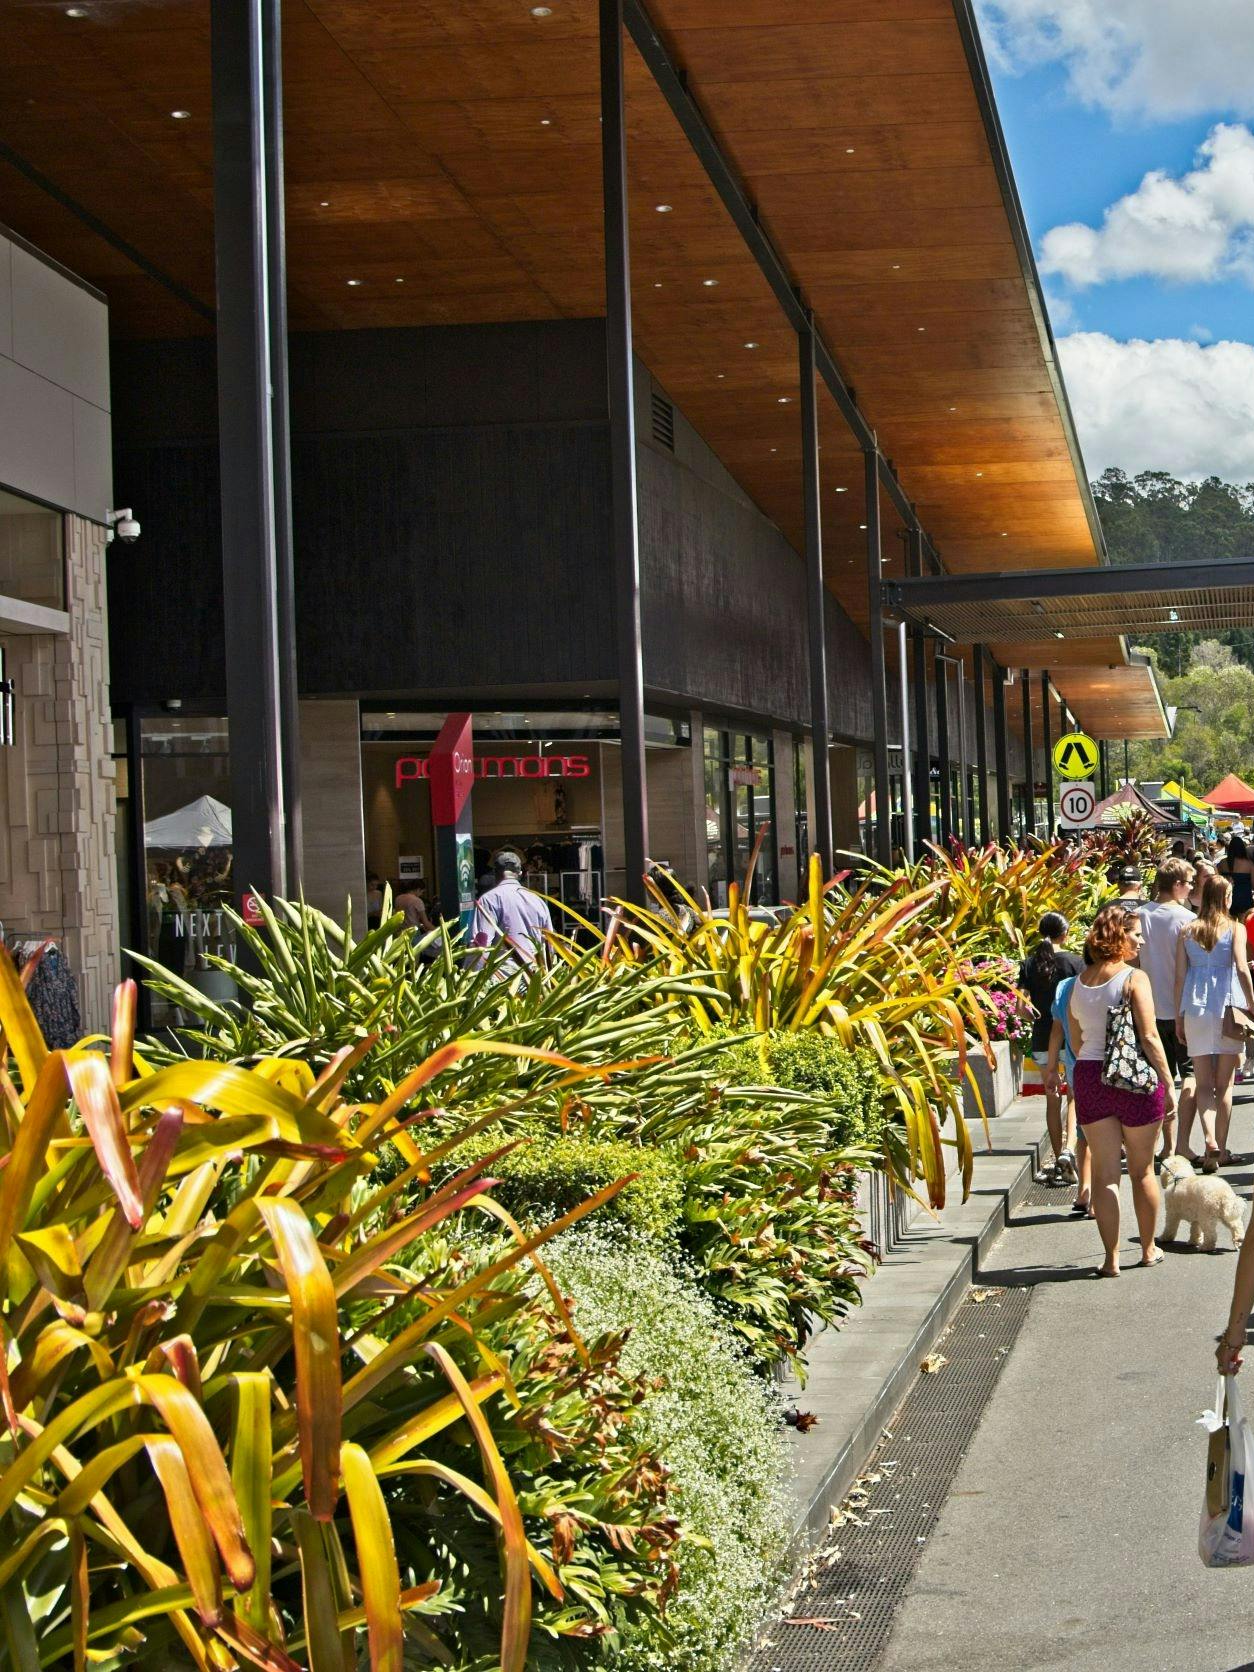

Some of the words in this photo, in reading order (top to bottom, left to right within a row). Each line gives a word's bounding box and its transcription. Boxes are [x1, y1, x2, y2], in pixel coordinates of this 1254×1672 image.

[395, 755, 591, 788] pmans
[1069, 796, 1088, 814] 10
[175, 913, 223, 938] NEXT
